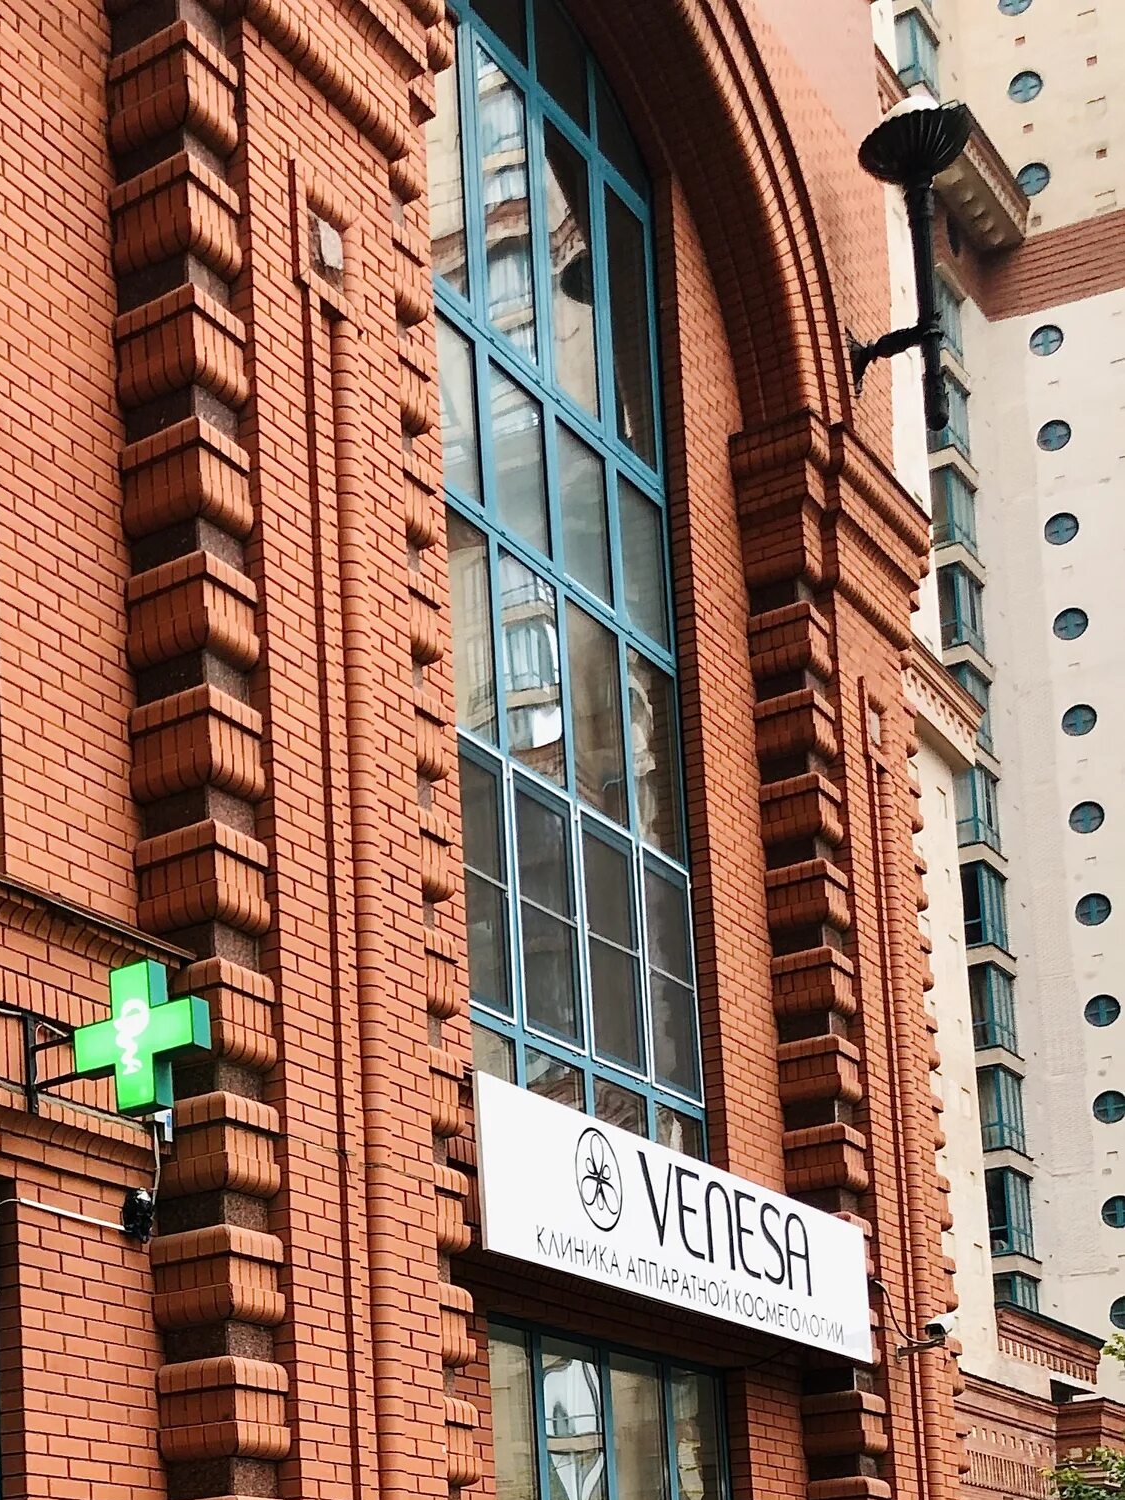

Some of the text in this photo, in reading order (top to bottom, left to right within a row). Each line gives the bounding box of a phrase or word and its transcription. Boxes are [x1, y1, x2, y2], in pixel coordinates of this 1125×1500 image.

[535, 1224, 846, 1346] КЛИНИКА АППАРАТНОЙ КОСМЕТОЛОГИИ
[636, 1150, 813, 1298] VENESA
